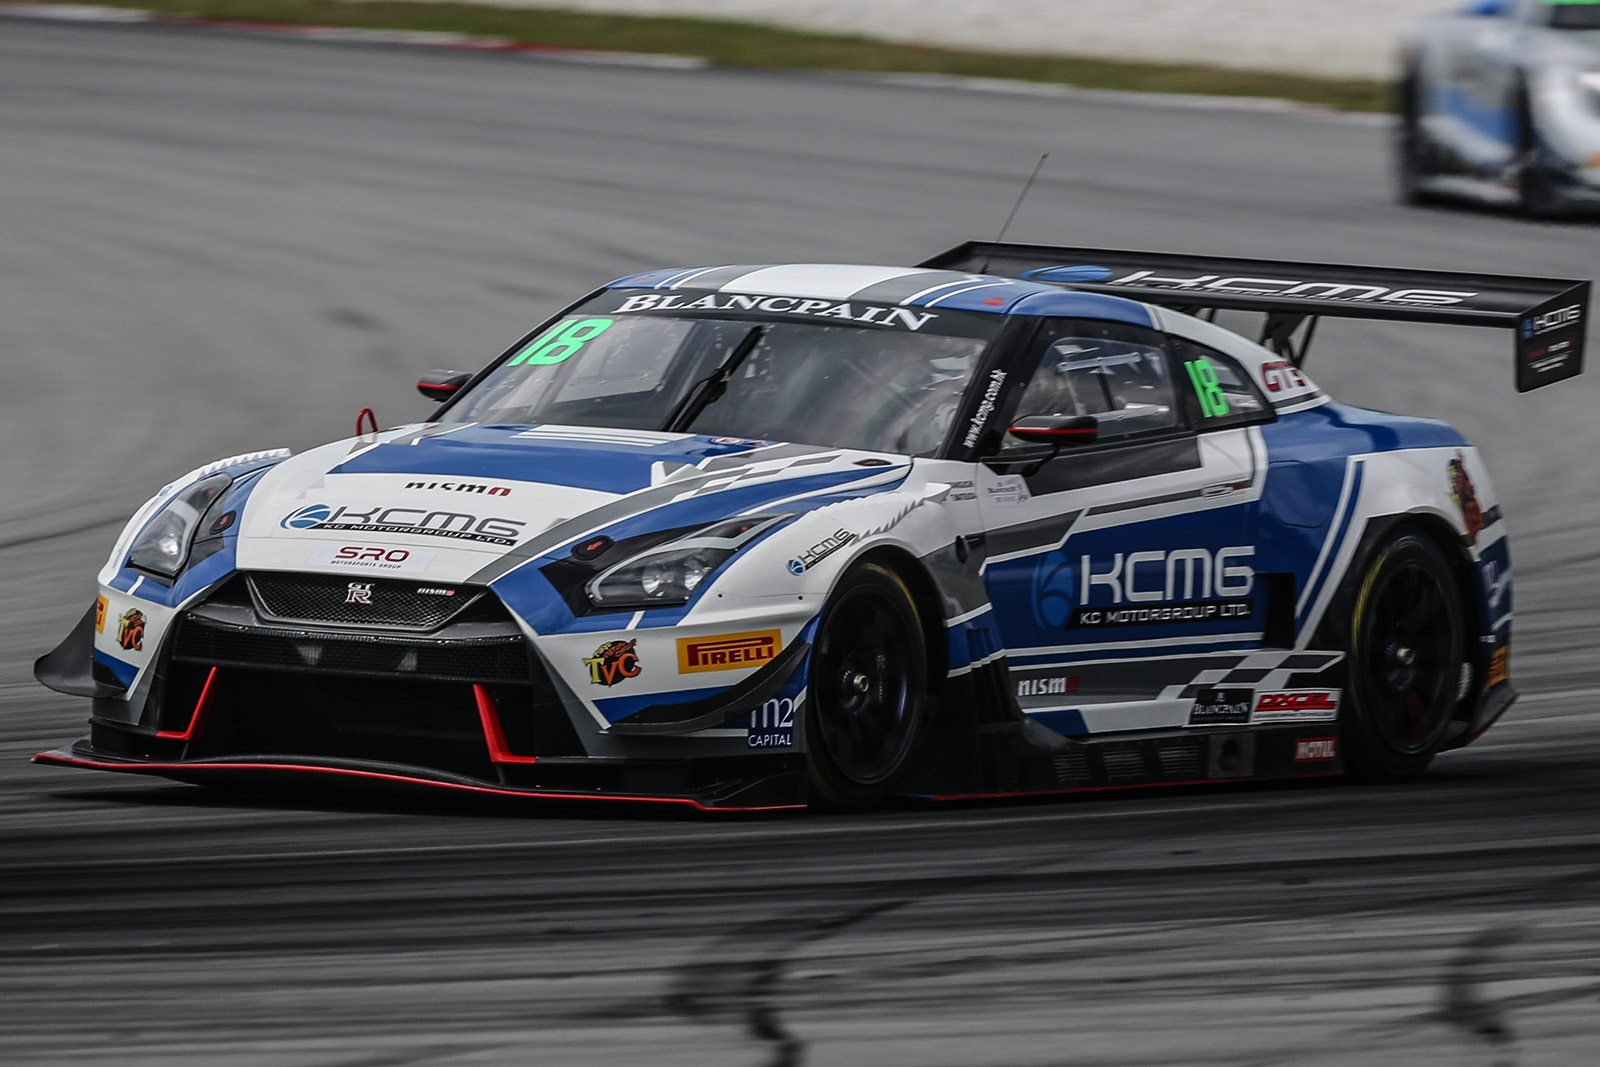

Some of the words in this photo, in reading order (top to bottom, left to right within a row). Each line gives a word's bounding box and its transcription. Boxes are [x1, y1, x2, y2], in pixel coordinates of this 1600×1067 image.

[1106, 270, 1478, 305] KCMG
[611, 293, 938, 331] BLANCPAIN
[506, 318, 614, 367] 18
[1184, 359, 1230, 418] 18
[329, 505, 527, 538] KCMG
[334, 546, 411, 563] SRO
[797, 527, 850, 565] KCMG
[1080, 545, 1256, 606] KCMG
[1080, 611, 1101, 625] KC
[1106, 605, 1216, 624] MOTORGROUP
[1220, 603, 1251, 617] LTD.
[686, 636, 774, 667] PIRELLI
[748, 733, 793, 747] CAPITAL
[1296, 740, 1336, 759] MOTUL
